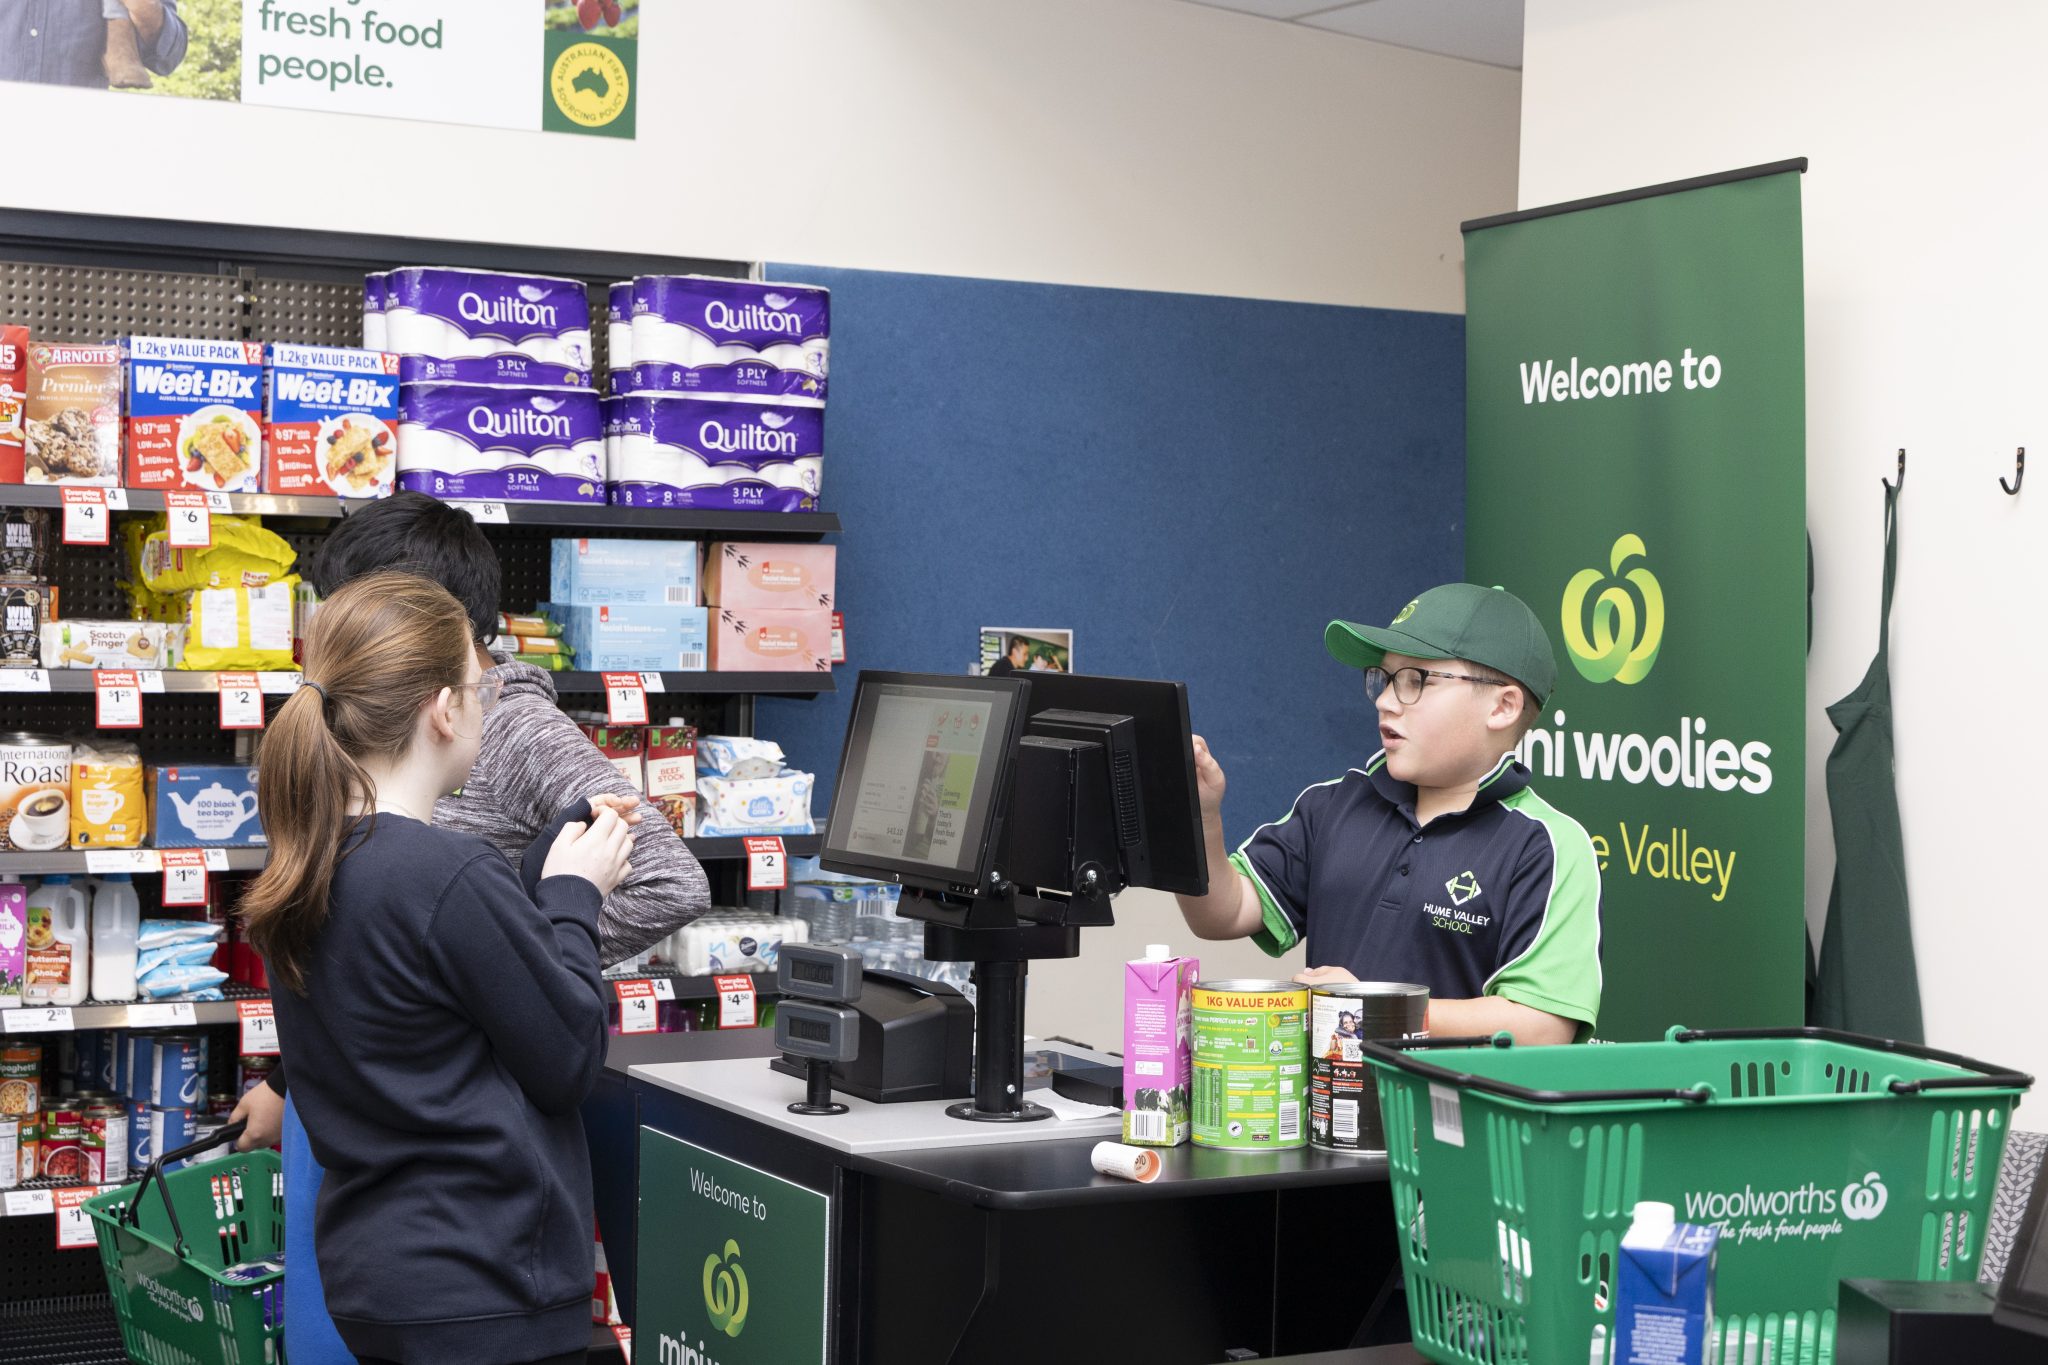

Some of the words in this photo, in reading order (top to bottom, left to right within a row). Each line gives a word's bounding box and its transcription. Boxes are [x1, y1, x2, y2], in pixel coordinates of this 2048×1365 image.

[259, 0, 350, 39] fresh
[361, 10, 443, 49] food
[258, 54, 393, 92] people.
[557, 48, 606, 81] AUSTRALIAN
[607, 58, 624, 87] FIRST
[557, 87, 597, 121] SOURCING
[599, 92, 624, 119] POLICY
[458, 292, 557, 327] Quilton
[704, 300, 802, 333] Quilton
[137, 342, 167, 357] 1.2kg
[170, 344, 206, 358] VALUE
[209, 346, 240, 359] PACK
[247, 344, 262, 358] 72
[280, 350, 308, 366] 1.2kg
[311, 352, 345, 367] VALUE
[348, 355, 378, 369] PACK
[383, 354, 399, 369] 72
[497, 359, 504, 370] 3
[507, 360, 527, 371] PLY
[426, 361, 436, 375] 8
[497, 370, 528, 379] SOFTNESS
[737, 367, 744, 379] 3
[747, 368, 768, 380] PLY
[136, 365, 258, 399] Weet-Bix
[672, 370, 681, 384] 8
[737, 379, 768, 387] SOFTNESS
[1519, 356, 1673, 405] Welcome
[1680, 348, 1722, 390] to
[42, 377, 106, 394] Premier
[277, 372, 394, 408] Weet-Bix
[467, 405, 571, 438] Quilton
[699, 420, 797, 453] Quilton
[435, 477, 445, 491] 8
[507, 472, 515, 484] 3
[517, 473, 540, 485] PLY
[507, 484, 540, 492] SOFTNESS
[733, 487, 740, 499] 3
[743, 487, 764, 500] PLY
[663, 490, 673, 503] 8
[733, 498, 764, 506] SOFTNESS
[6, 523, 31, 536] WIN
[6, 605, 32, 618] WIN
[89, 630, 126, 639] Scotch
[91, 639, 124, 650] Finger
[1516, 709, 1567, 778] ni
[1572, 715, 1773, 795] woolies
[4, 761, 69, 785] Roast
[660, 766, 681, 775] BEEF
[657, 774, 685, 783] STOCK
[197, 800, 212, 808] 100
[213, 800, 237, 808] black
[213, 809, 234, 818] bags
[762, 855, 775, 867] $2
[1619, 822, 1736, 902] Valley
[1423, 902, 1452, 918] HUME
[1453, 910, 1491, 927] VALLEY
[1432, 916, 1473, 935] SCHOOL
[28, 955, 70, 963] Buttermilk
[633, 999, 646, 1011] $4
[1207, 995, 1223, 1007] 1KG
[1226, 997, 1264, 1008] VALUE
[1267, 997, 1294, 1008] PACK
[690, 1167, 750, 1214] Welcome
[752, 1195, 766, 1221] to
[1708, 1220, 1736, 1239] The
[1737, 1219, 1773, 1246] fresh
[1774, 1219, 1802, 1243] food
[1803, 1218, 1843, 1241] people
